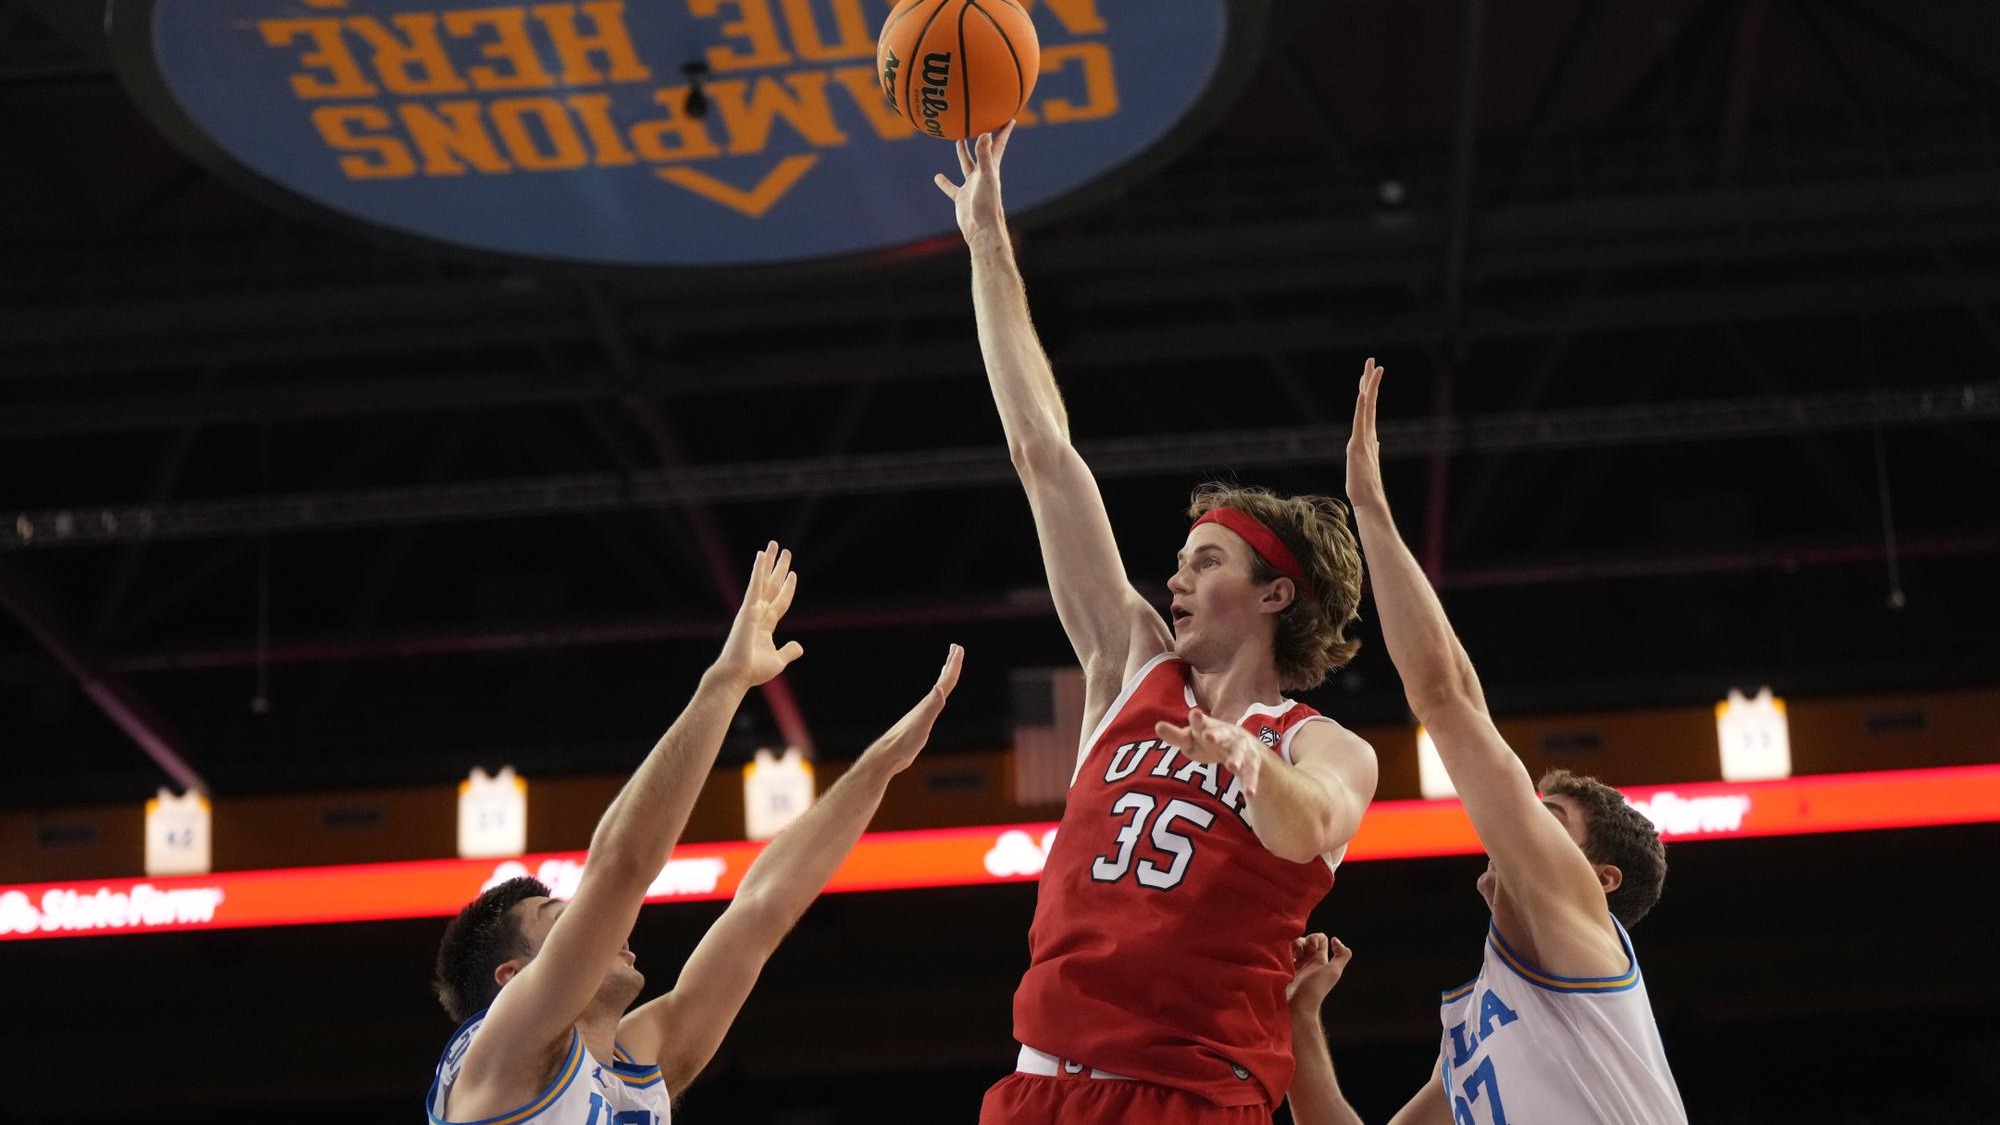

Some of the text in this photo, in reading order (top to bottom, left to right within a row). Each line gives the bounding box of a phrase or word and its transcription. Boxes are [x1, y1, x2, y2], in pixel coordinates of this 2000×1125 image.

[258, 0, 651, 100] HERE
[922, 52, 951, 137] Wilson
[311, 43, 1119, 180] CAMPIONS
[1090, 791, 1216, 892] 35
